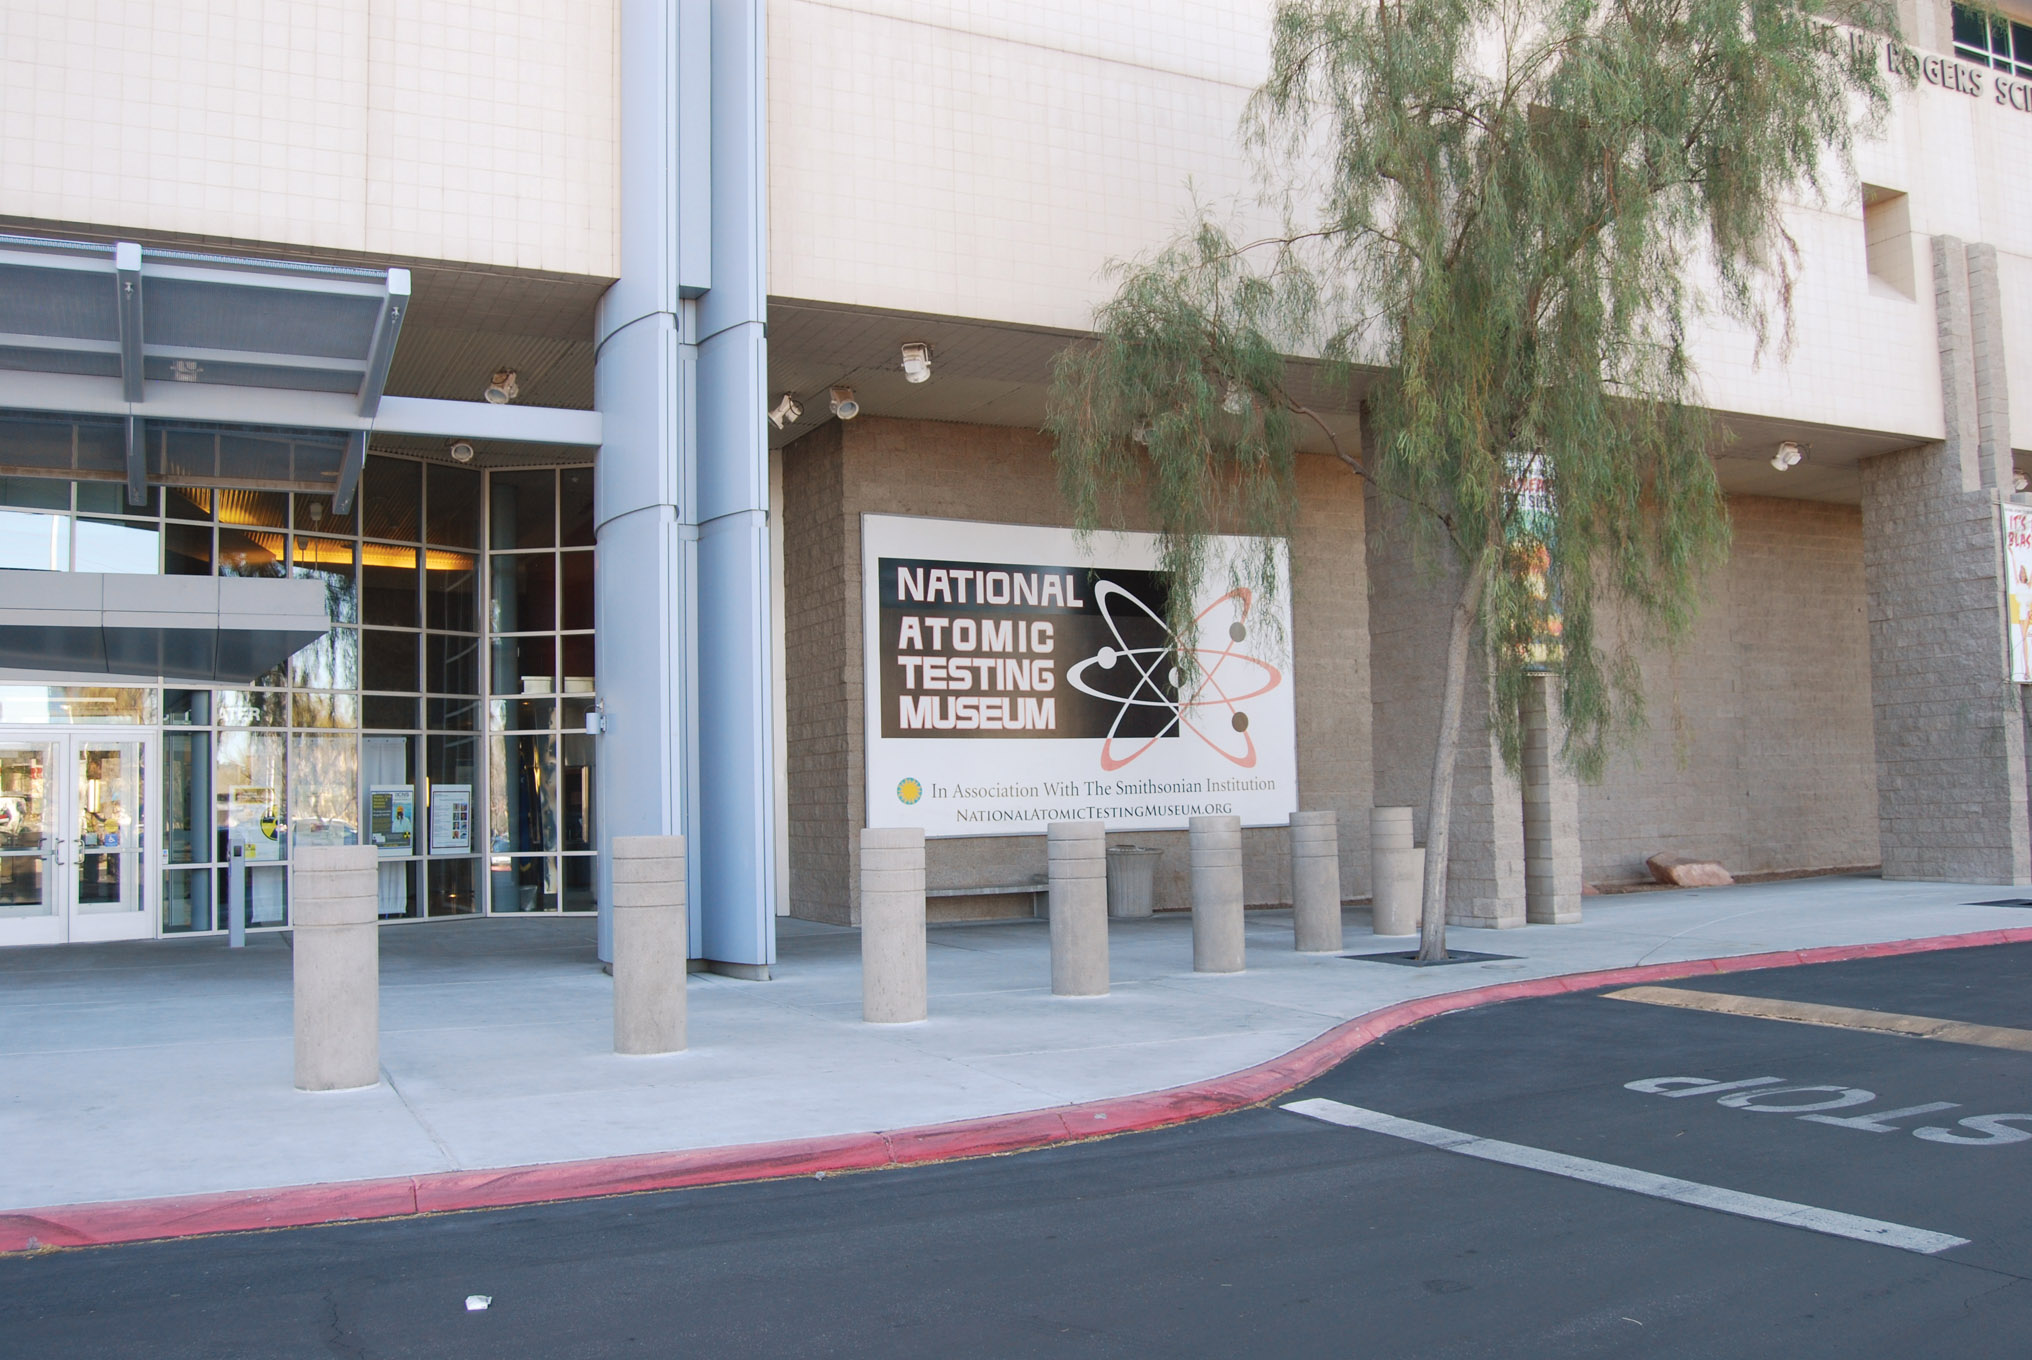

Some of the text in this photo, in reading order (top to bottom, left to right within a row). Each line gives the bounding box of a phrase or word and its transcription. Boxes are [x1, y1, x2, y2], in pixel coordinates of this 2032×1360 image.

[897, 566, 1084, 608] NATIONAL
[898, 616, 1055, 654] ATOMIC
[897, 655, 1055, 691] TESTING
[899, 695, 1056, 730] MUSEUM
[932, 776, 1276, 799] In Association With The Smithsonian Institution
[1623, 1075, 2032, 1146] STOP
